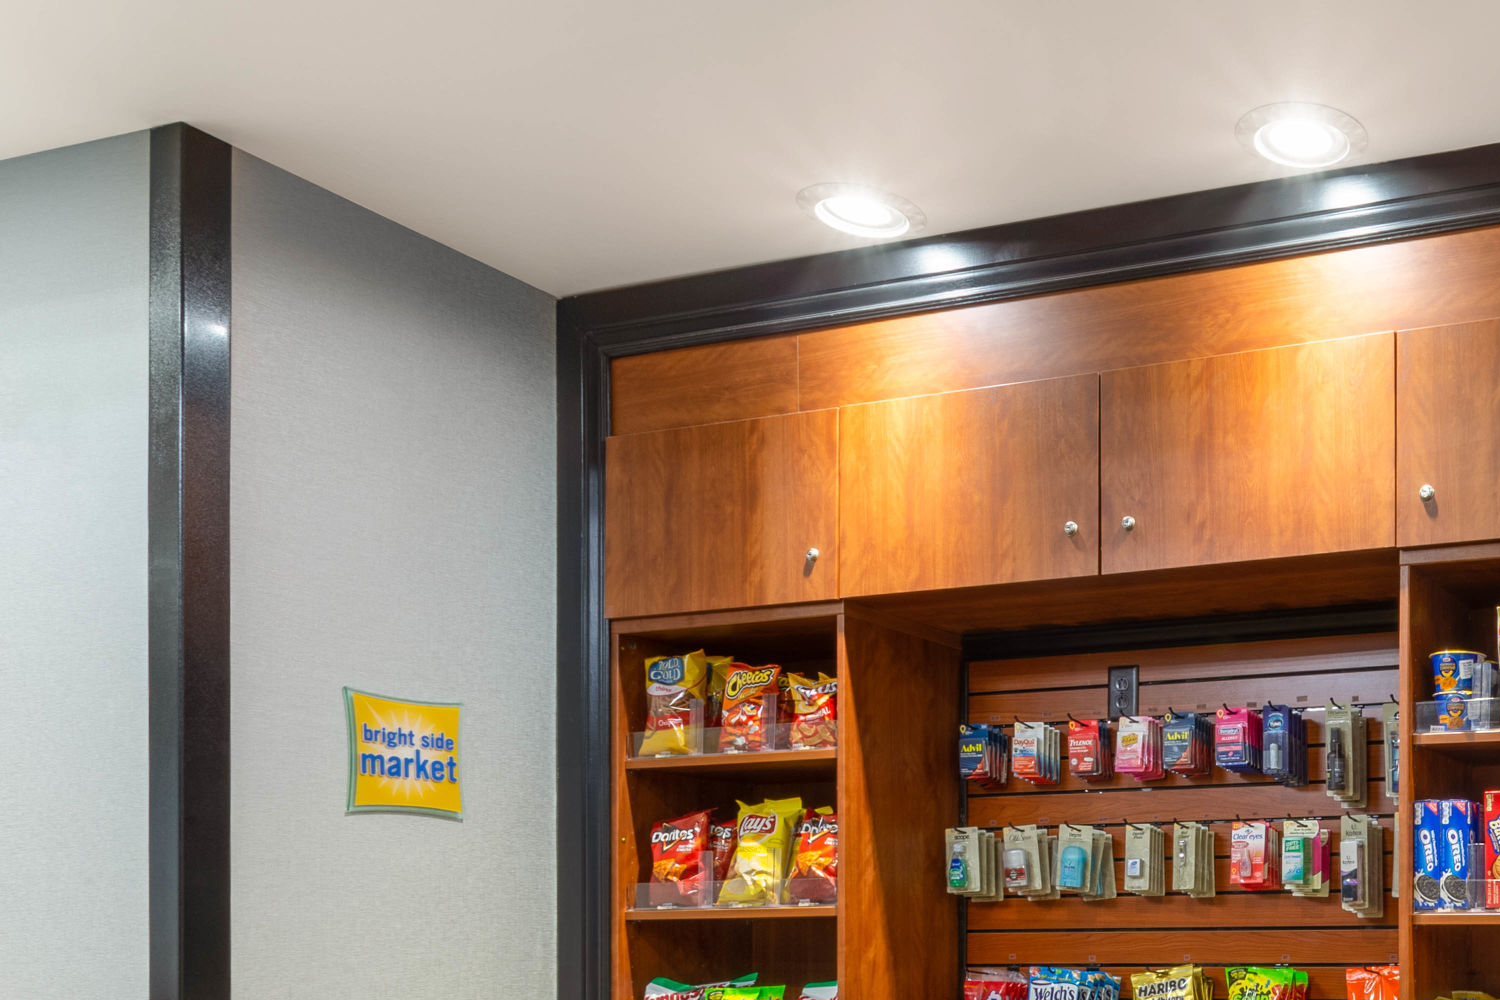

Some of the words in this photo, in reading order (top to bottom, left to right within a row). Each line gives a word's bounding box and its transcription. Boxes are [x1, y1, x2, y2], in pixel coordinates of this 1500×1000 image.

[650, 668, 681, 681] GOLD
[726, 668, 775, 700] Cheetos
[362, 722, 415, 748] bright
[421, 732, 454, 751] side
[1165, 731, 1189, 741] Advil
[961, 743, 982, 753] Advil
[360, 748, 457, 783] market
[739, 812, 777, 835] Lay's
[651, 828, 695, 844] Doritos
[1233, 832, 1248, 841] Clear
[1248, 832, 1264, 841] eyes
[1419, 828, 1434, 872] OREO
[1447, 828, 1462, 872] OREO
[1138, 977, 1188, 998] HARIBO
